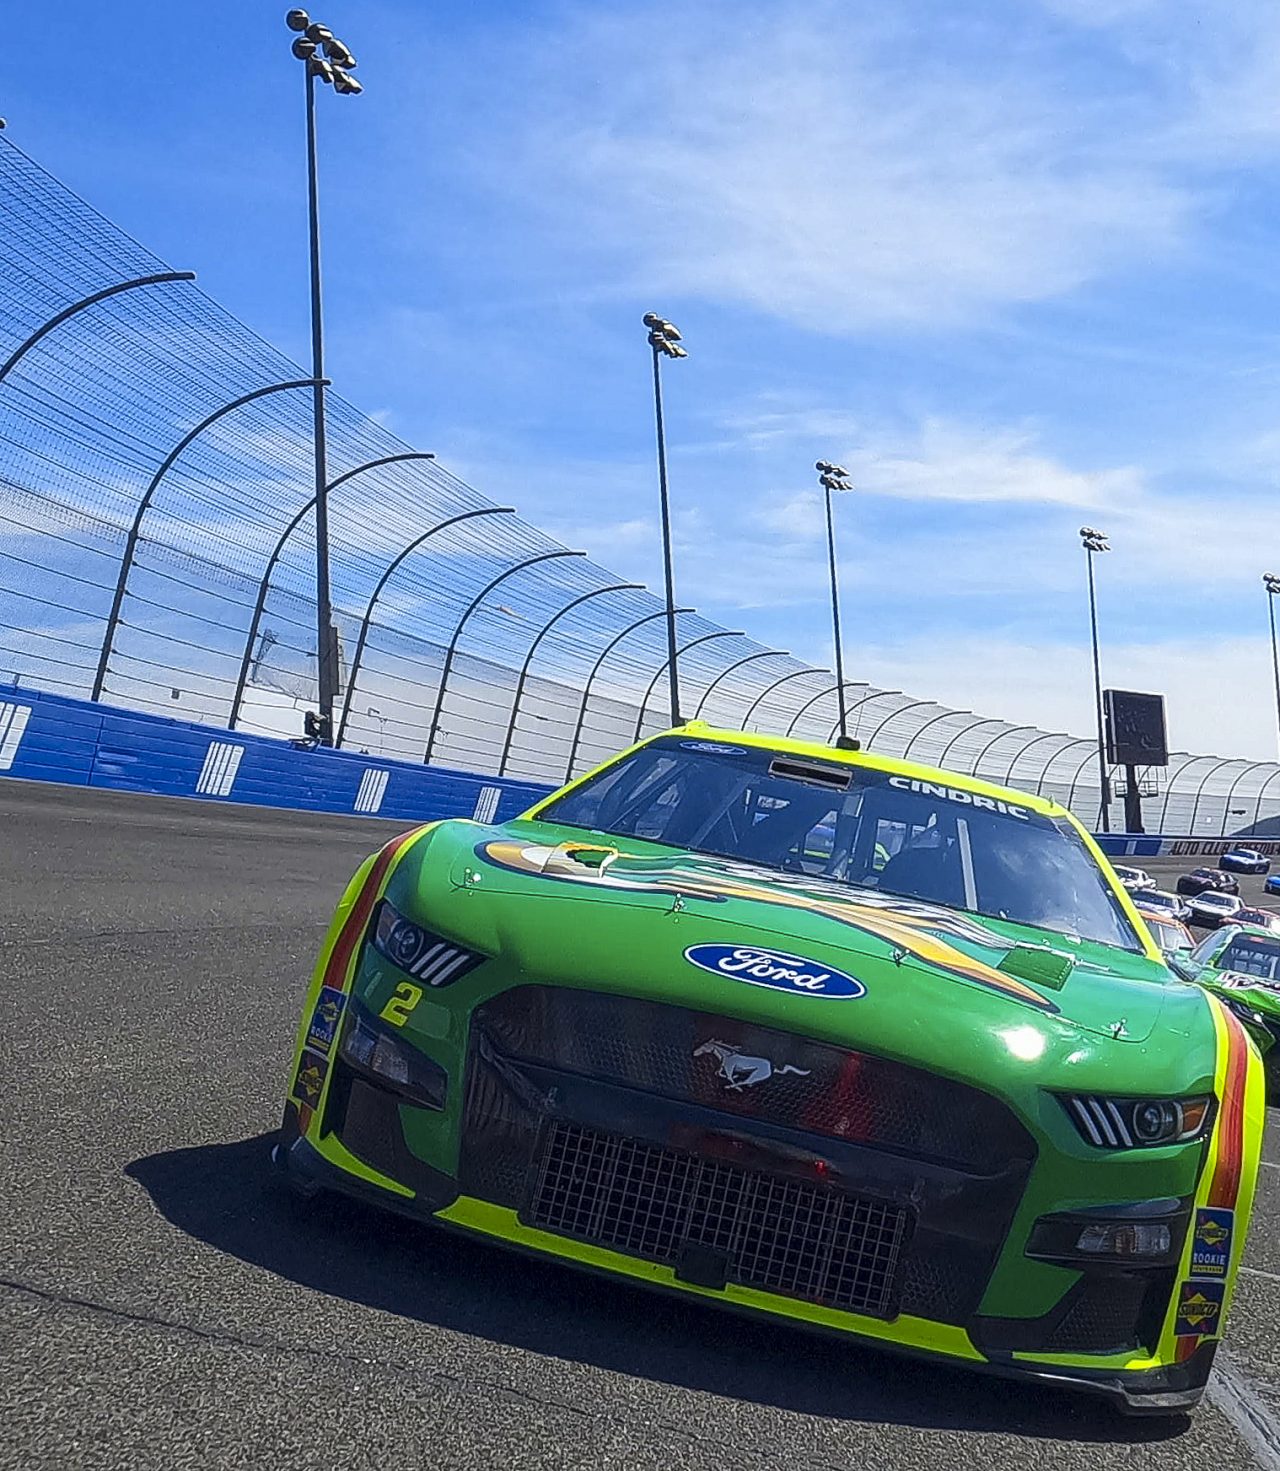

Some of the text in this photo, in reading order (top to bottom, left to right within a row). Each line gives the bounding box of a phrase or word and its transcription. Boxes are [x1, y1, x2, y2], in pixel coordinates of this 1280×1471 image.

[888, 776, 1030, 821] CINDRIC
[1168, 840, 1200, 856] AUTO
[718, 949, 831, 990] Ford
[379, 982, 423, 1028] 2
[1192, 1252, 1227, 1265] ROOKIE
